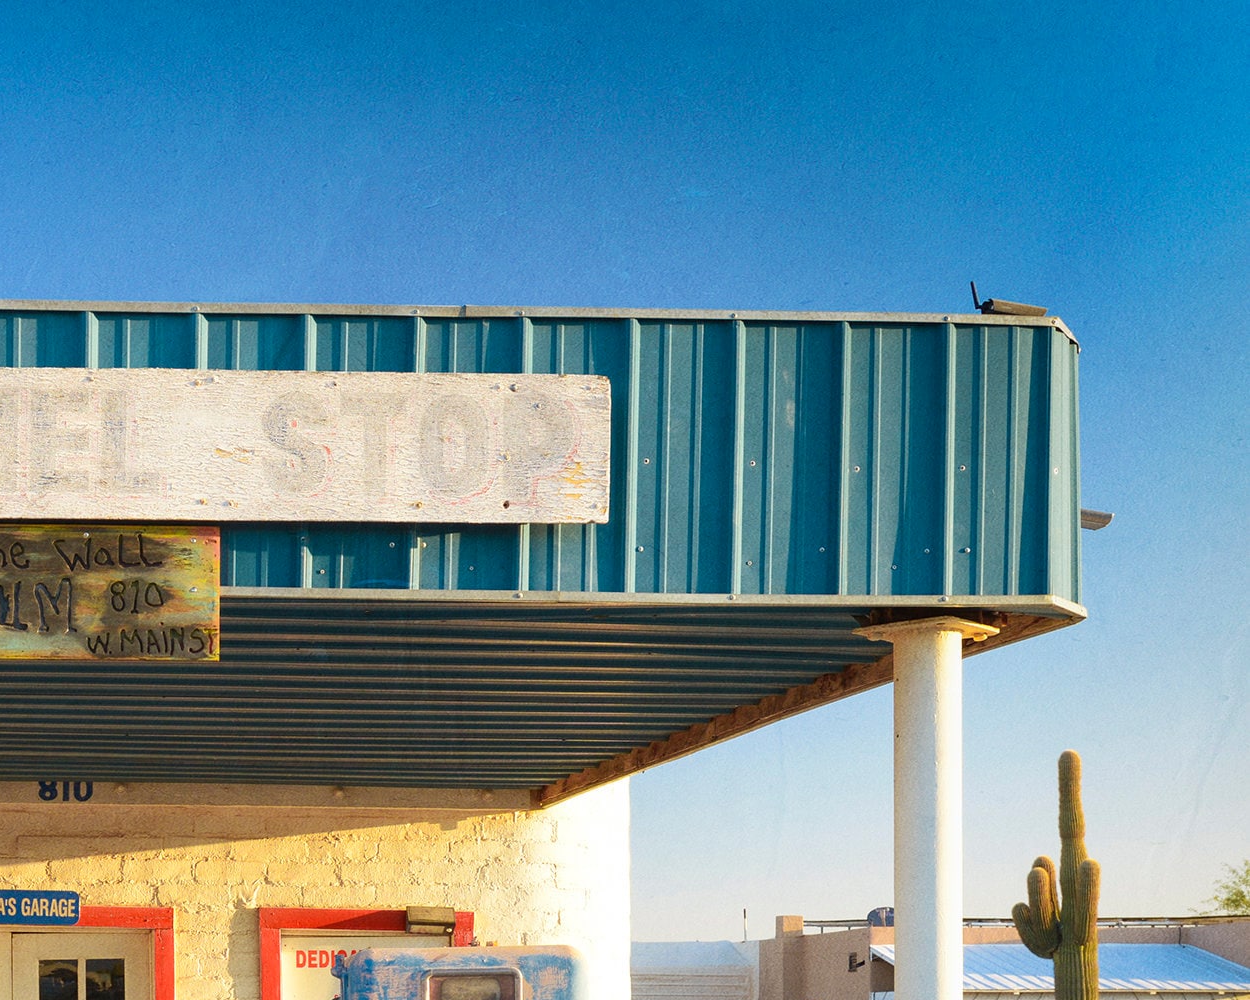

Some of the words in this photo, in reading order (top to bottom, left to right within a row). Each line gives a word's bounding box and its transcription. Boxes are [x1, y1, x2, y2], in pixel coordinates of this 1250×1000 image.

[261, 388, 577, 500] STOP
[109, 579, 166, 614] 810
[38, 780, 94, 802] 810
[21, 897, 76, 918] GARAGE
